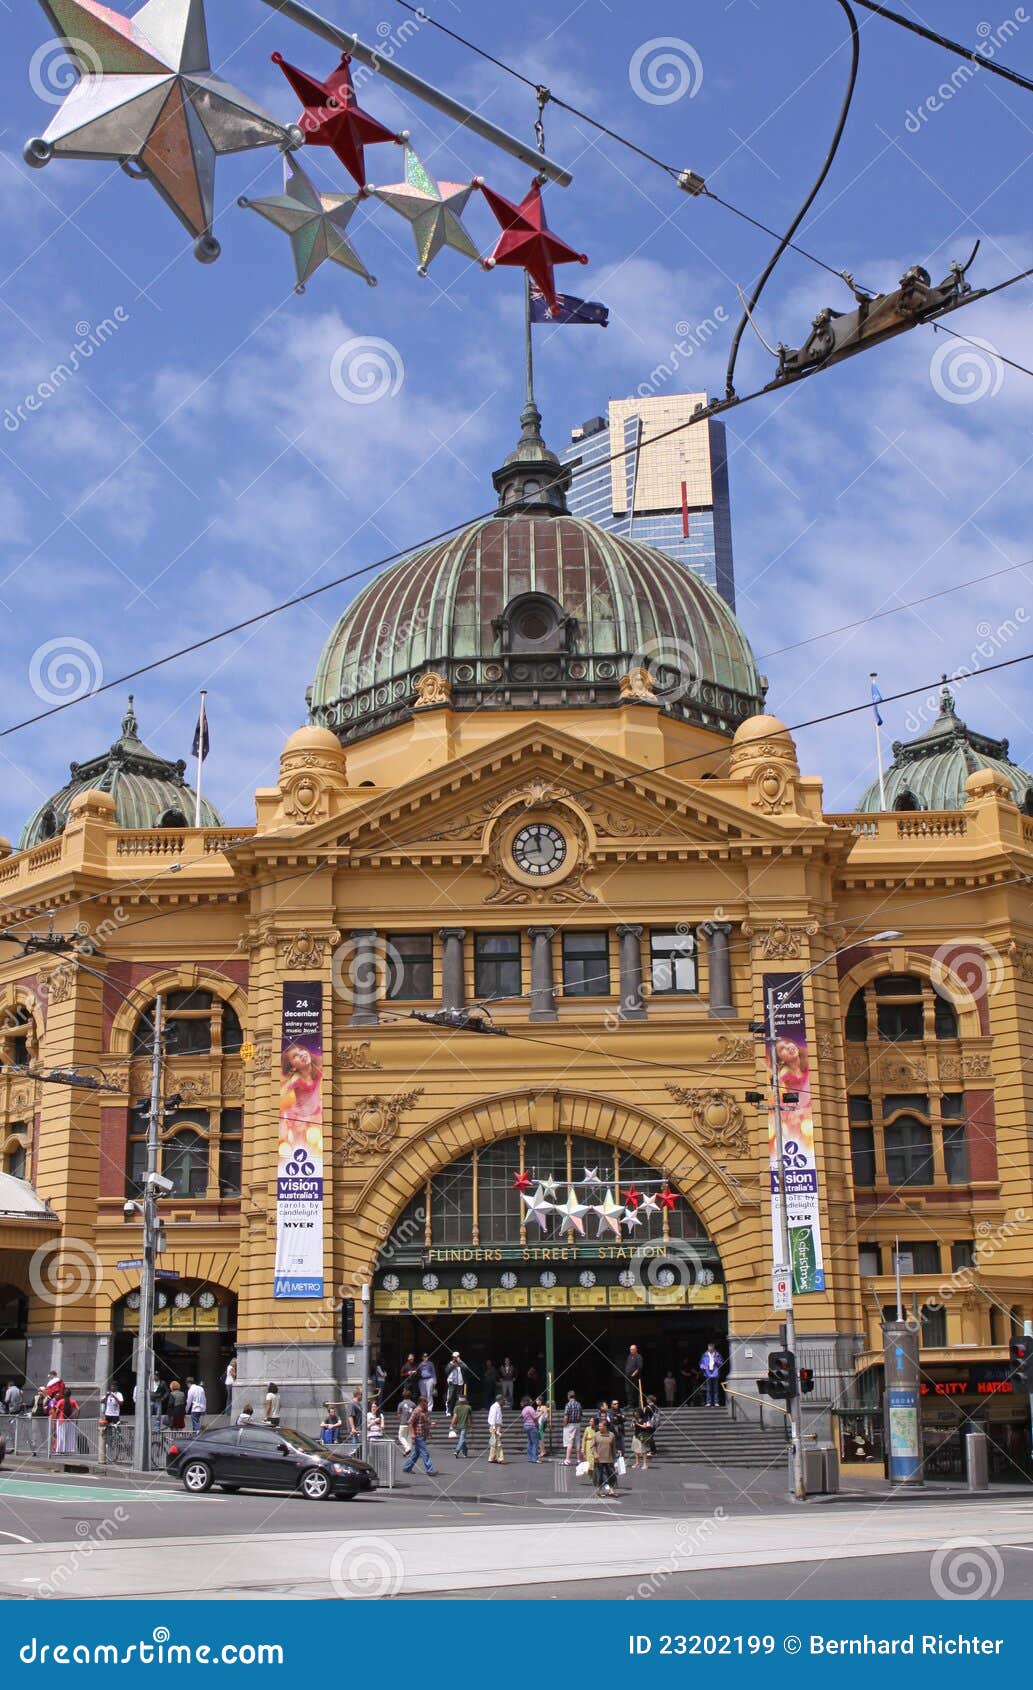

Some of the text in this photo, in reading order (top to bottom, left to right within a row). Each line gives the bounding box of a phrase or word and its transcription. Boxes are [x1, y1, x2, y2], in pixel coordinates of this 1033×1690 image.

[296, 1000, 309, 1008] 24
[279, 1180, 319, 1191] vision
[279, 1192, 319, 1200] australia's
[309, 1202, 319, 1210] by
[279, 1209, 319, 1217] candlelight
[427, 1246, 668, 1262] FLINDERS STREET STATION
[291, 1284, 320, 1292] METRO
[935, 1382, 967, 1395] CITY
